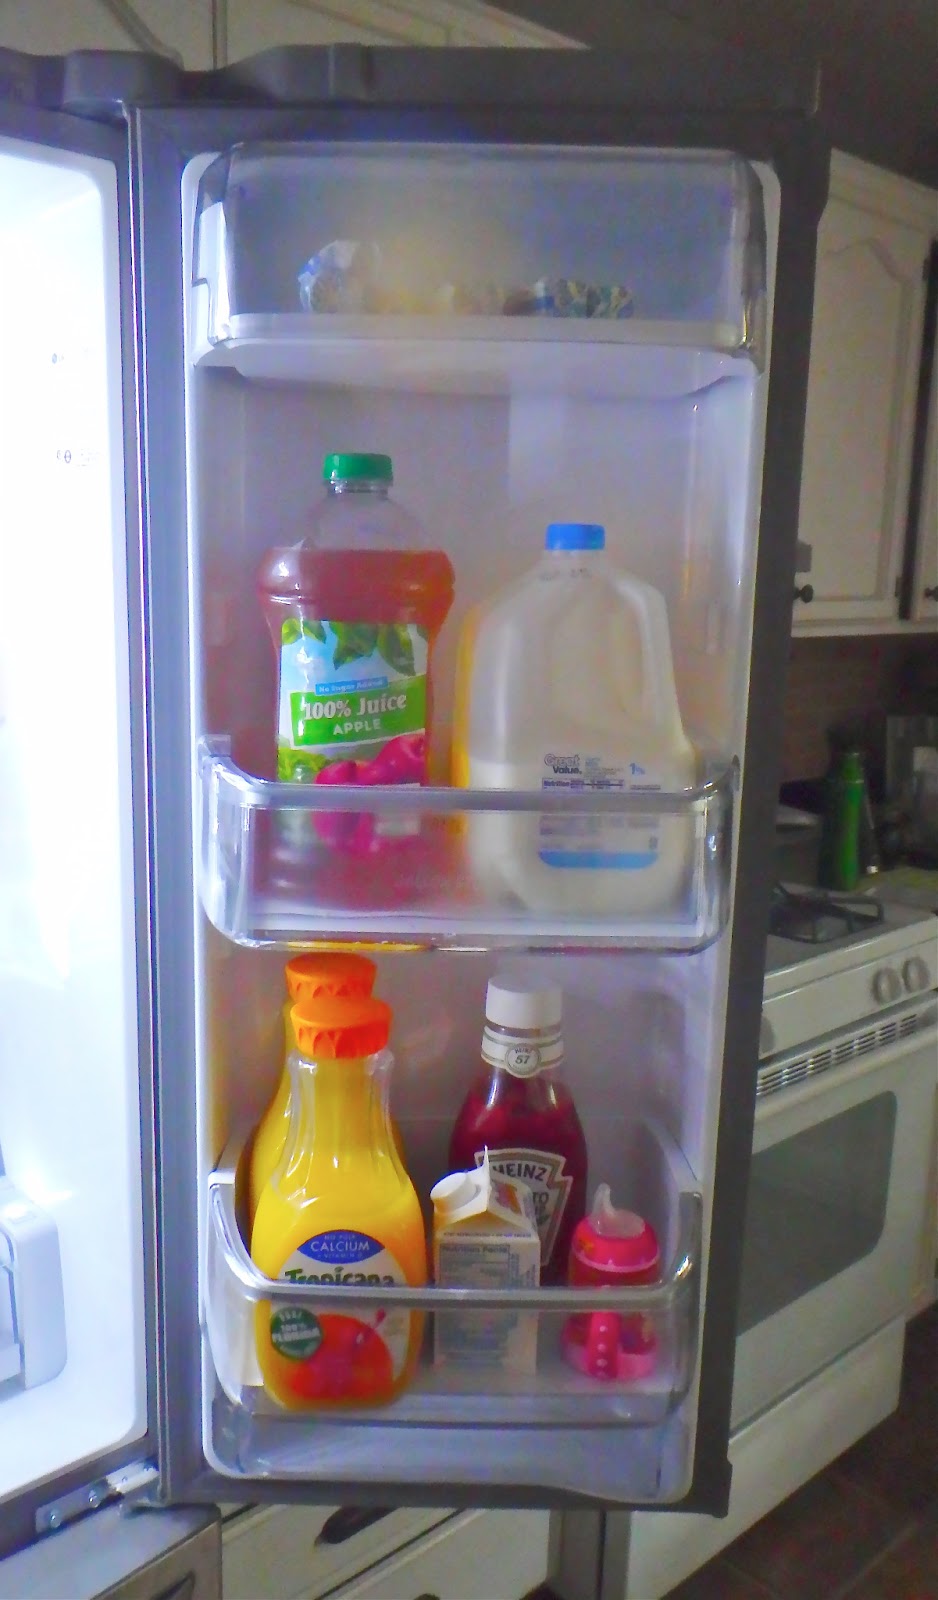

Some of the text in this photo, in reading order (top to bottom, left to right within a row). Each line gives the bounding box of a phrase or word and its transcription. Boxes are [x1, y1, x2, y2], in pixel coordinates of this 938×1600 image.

[318, 685, 330, 693] No
[303, 693, 407, 721] 100% Juice
[333, 718, 382, 736] APPLE
[514, 1054, 531, 1065] 57
[310, 1240, 370, 1252] CALCIUM
